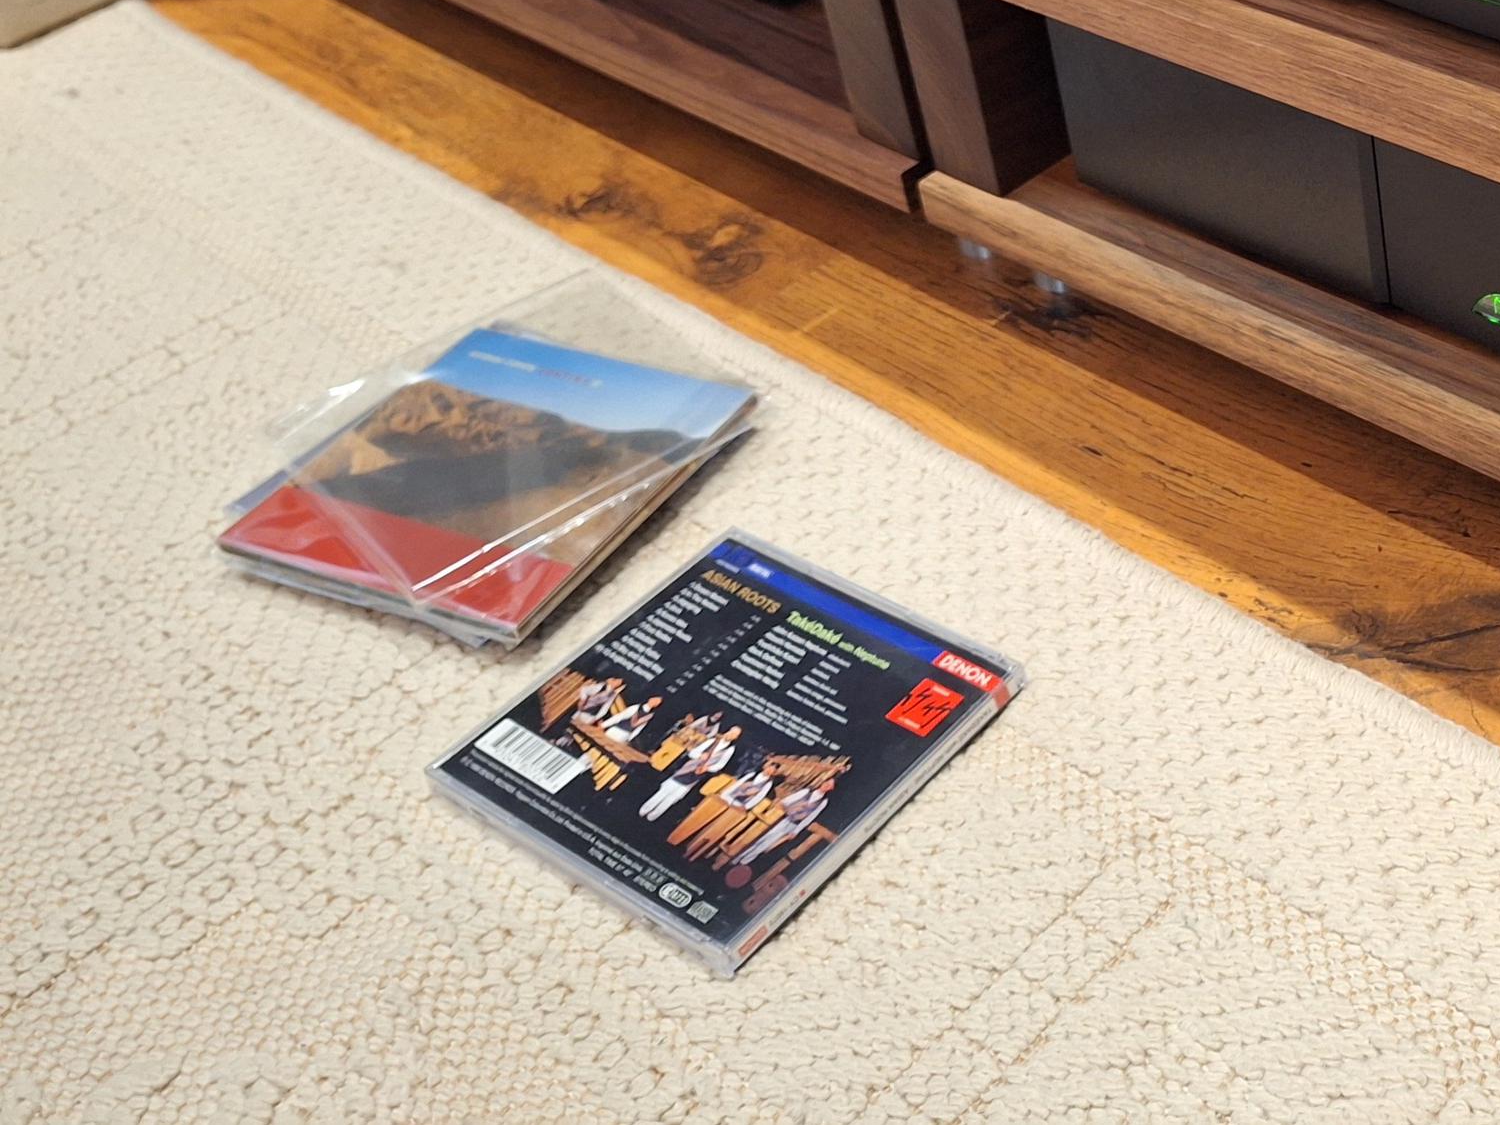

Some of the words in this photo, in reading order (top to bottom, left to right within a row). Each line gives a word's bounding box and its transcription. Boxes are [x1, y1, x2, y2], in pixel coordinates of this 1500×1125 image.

[702, 569, 742, 595] ASIAN
[735, 587, 782, 614] ROOTS
[939, 654, 993, 686] DENON
